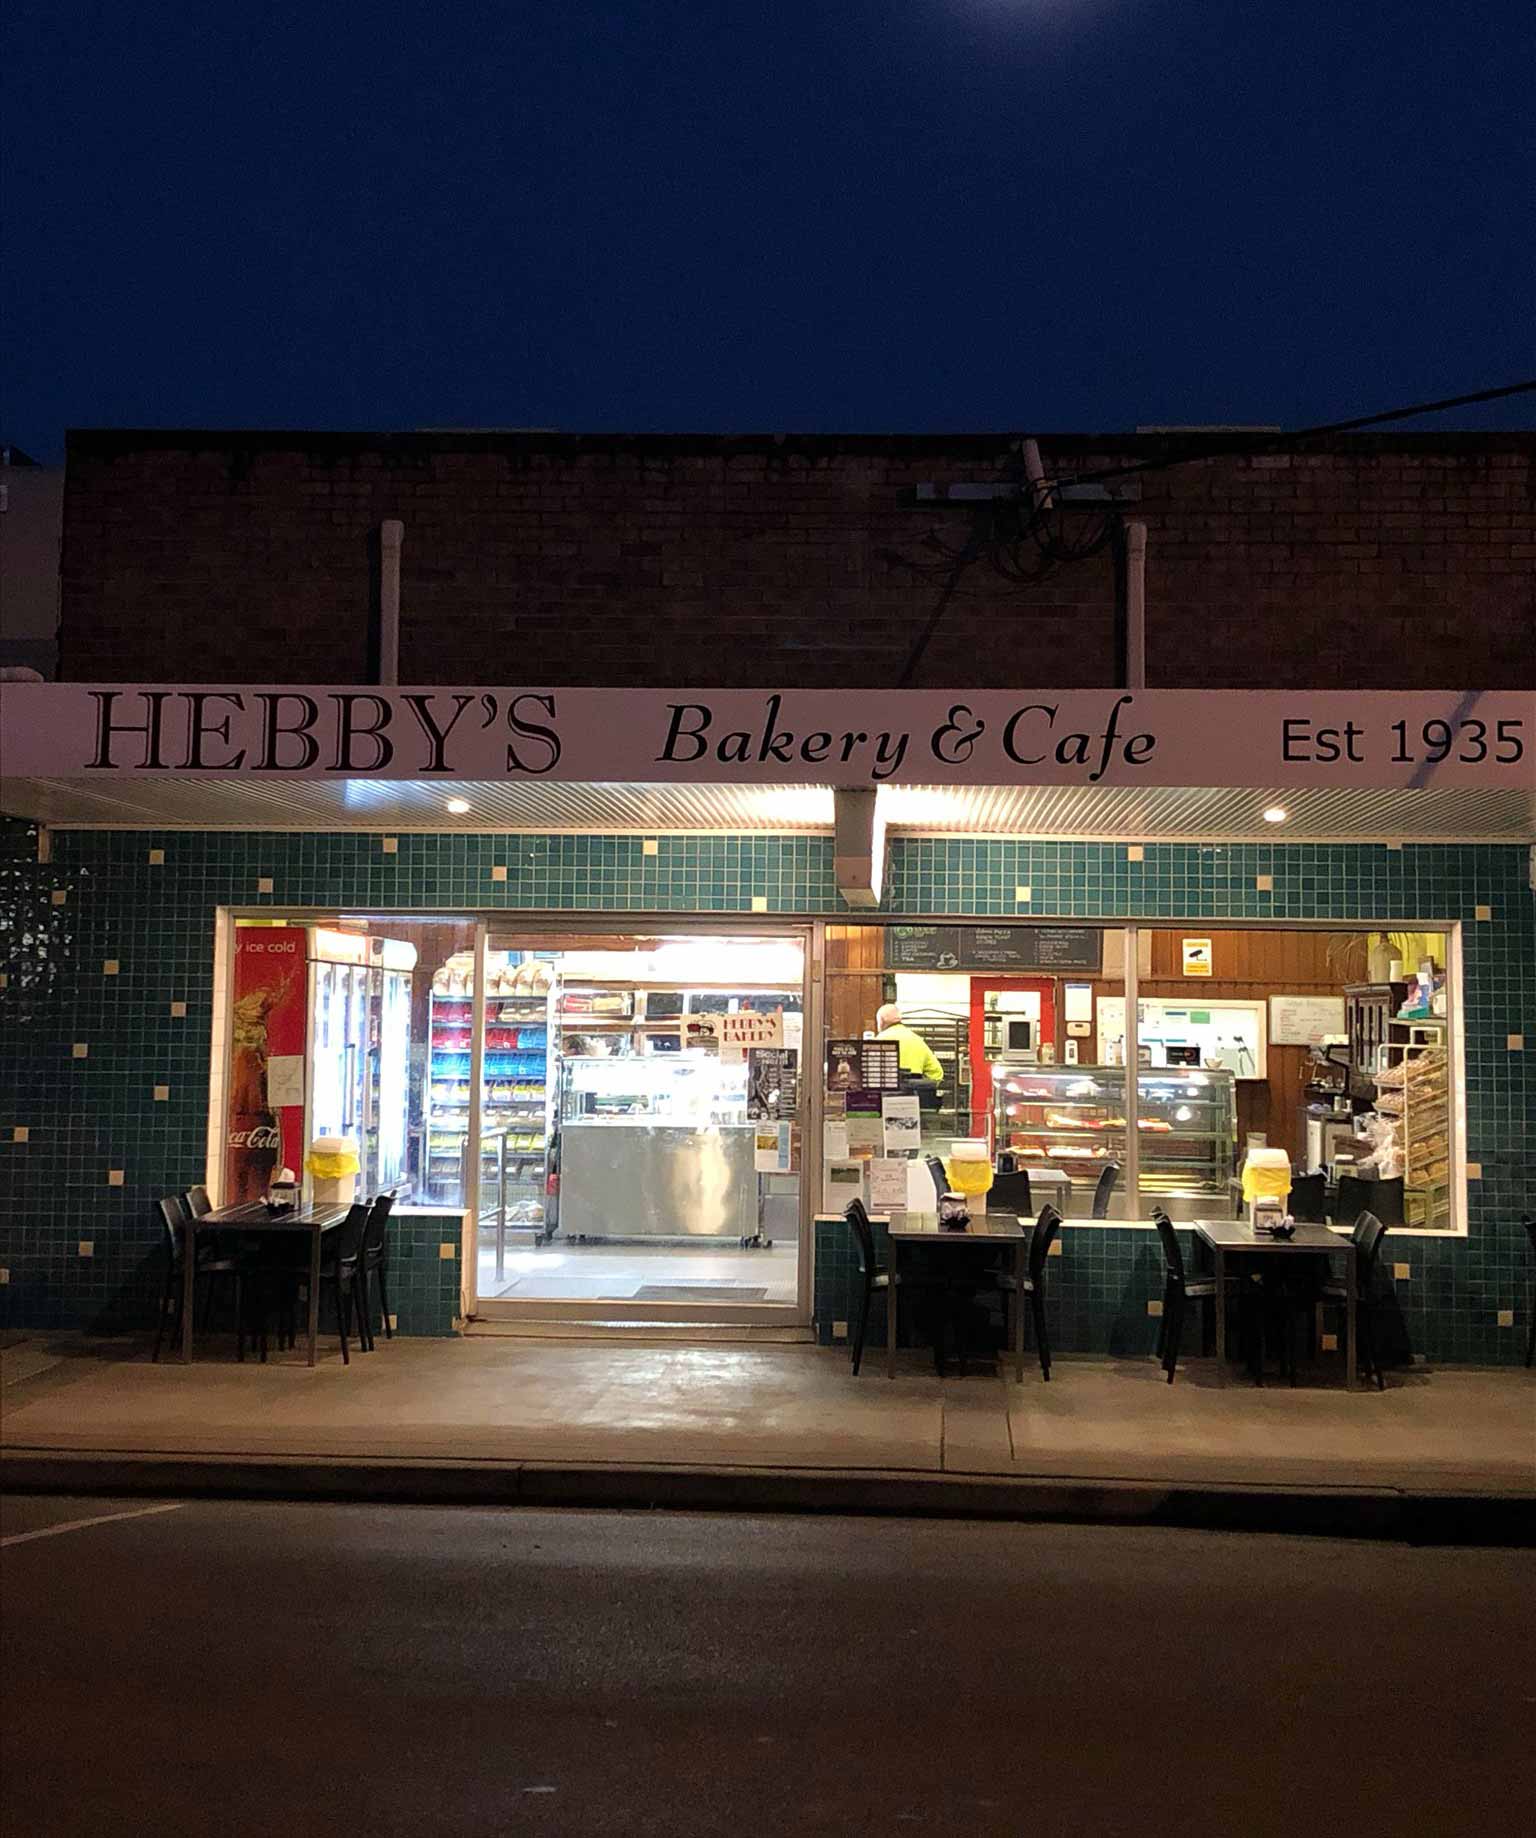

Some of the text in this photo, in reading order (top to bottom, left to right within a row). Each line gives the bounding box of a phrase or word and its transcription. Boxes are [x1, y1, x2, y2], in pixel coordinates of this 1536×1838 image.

[84, 691, 561, 774] HEBBY'S
[654, 694, 1156, 782] Bakery & Cafe
[1282, 719, 1524, 763] Est 1935
[245, 941, 264, 953] ice
[267, 941, 296, 953] cold
